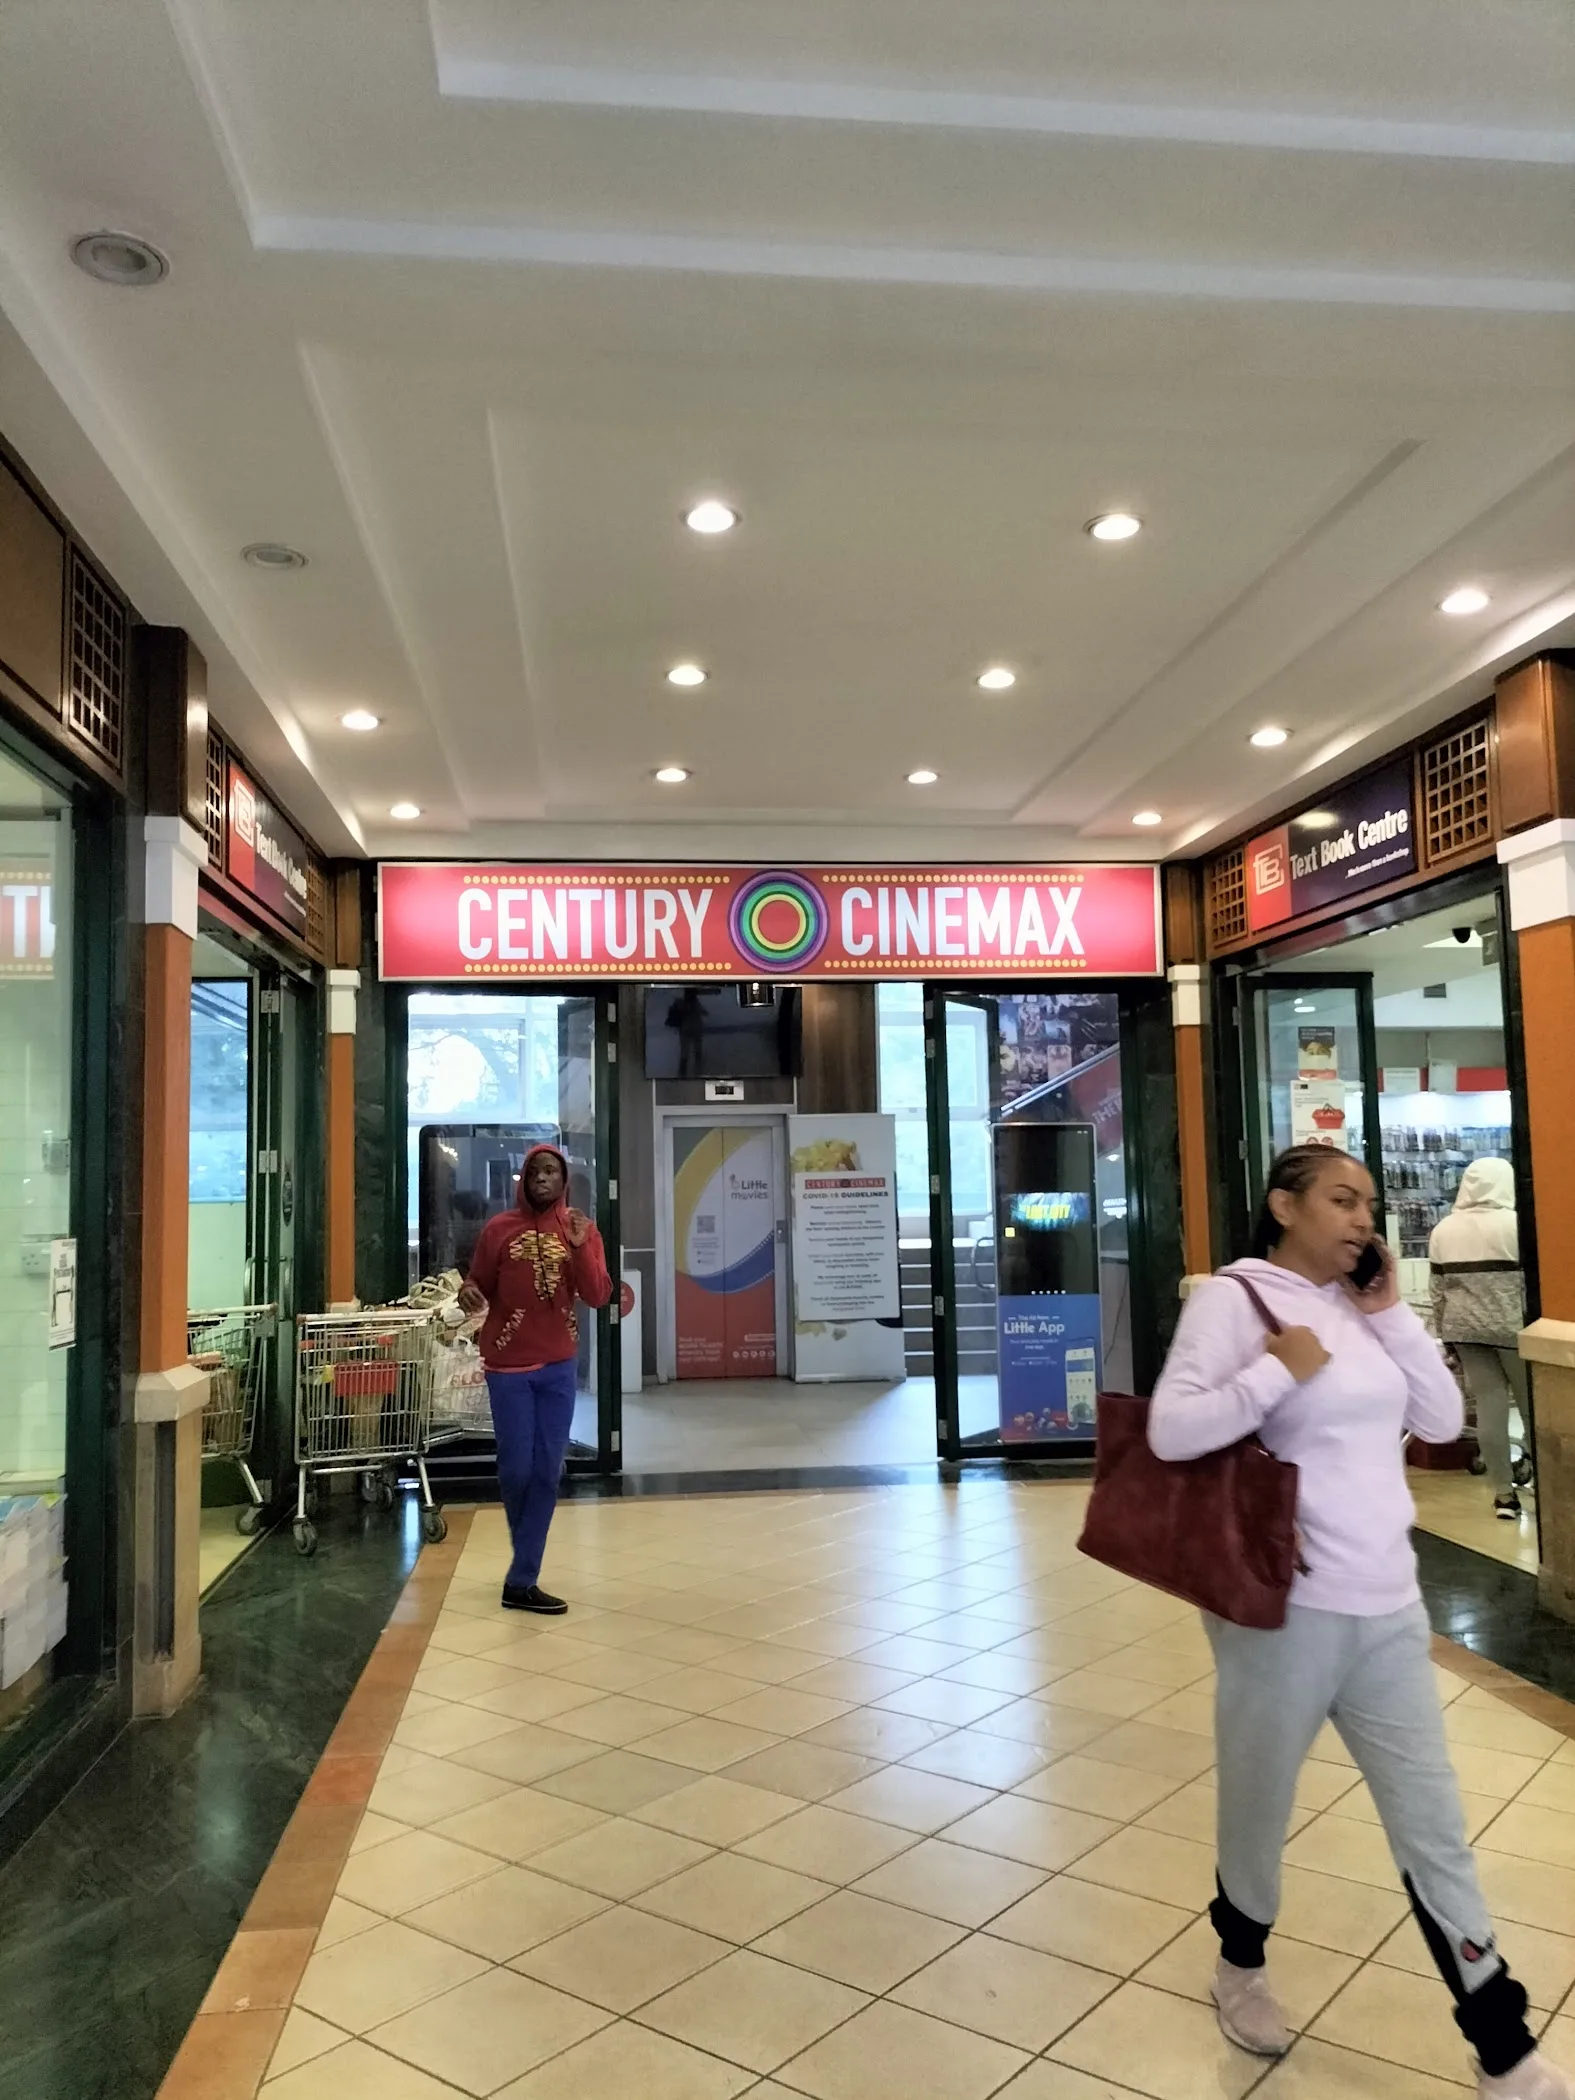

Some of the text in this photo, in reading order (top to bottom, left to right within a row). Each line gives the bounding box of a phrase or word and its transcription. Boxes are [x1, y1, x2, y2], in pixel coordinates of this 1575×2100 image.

[1290, 808, 1409, 880] Text Book Centre
[458, 887, 1085, 960] CENTURY CINEMAX
[741, 1180, 768, 1190] Little
[731, 1191, 768, 1200] movies
[1004, 1321, 1065, 1335] Little App
